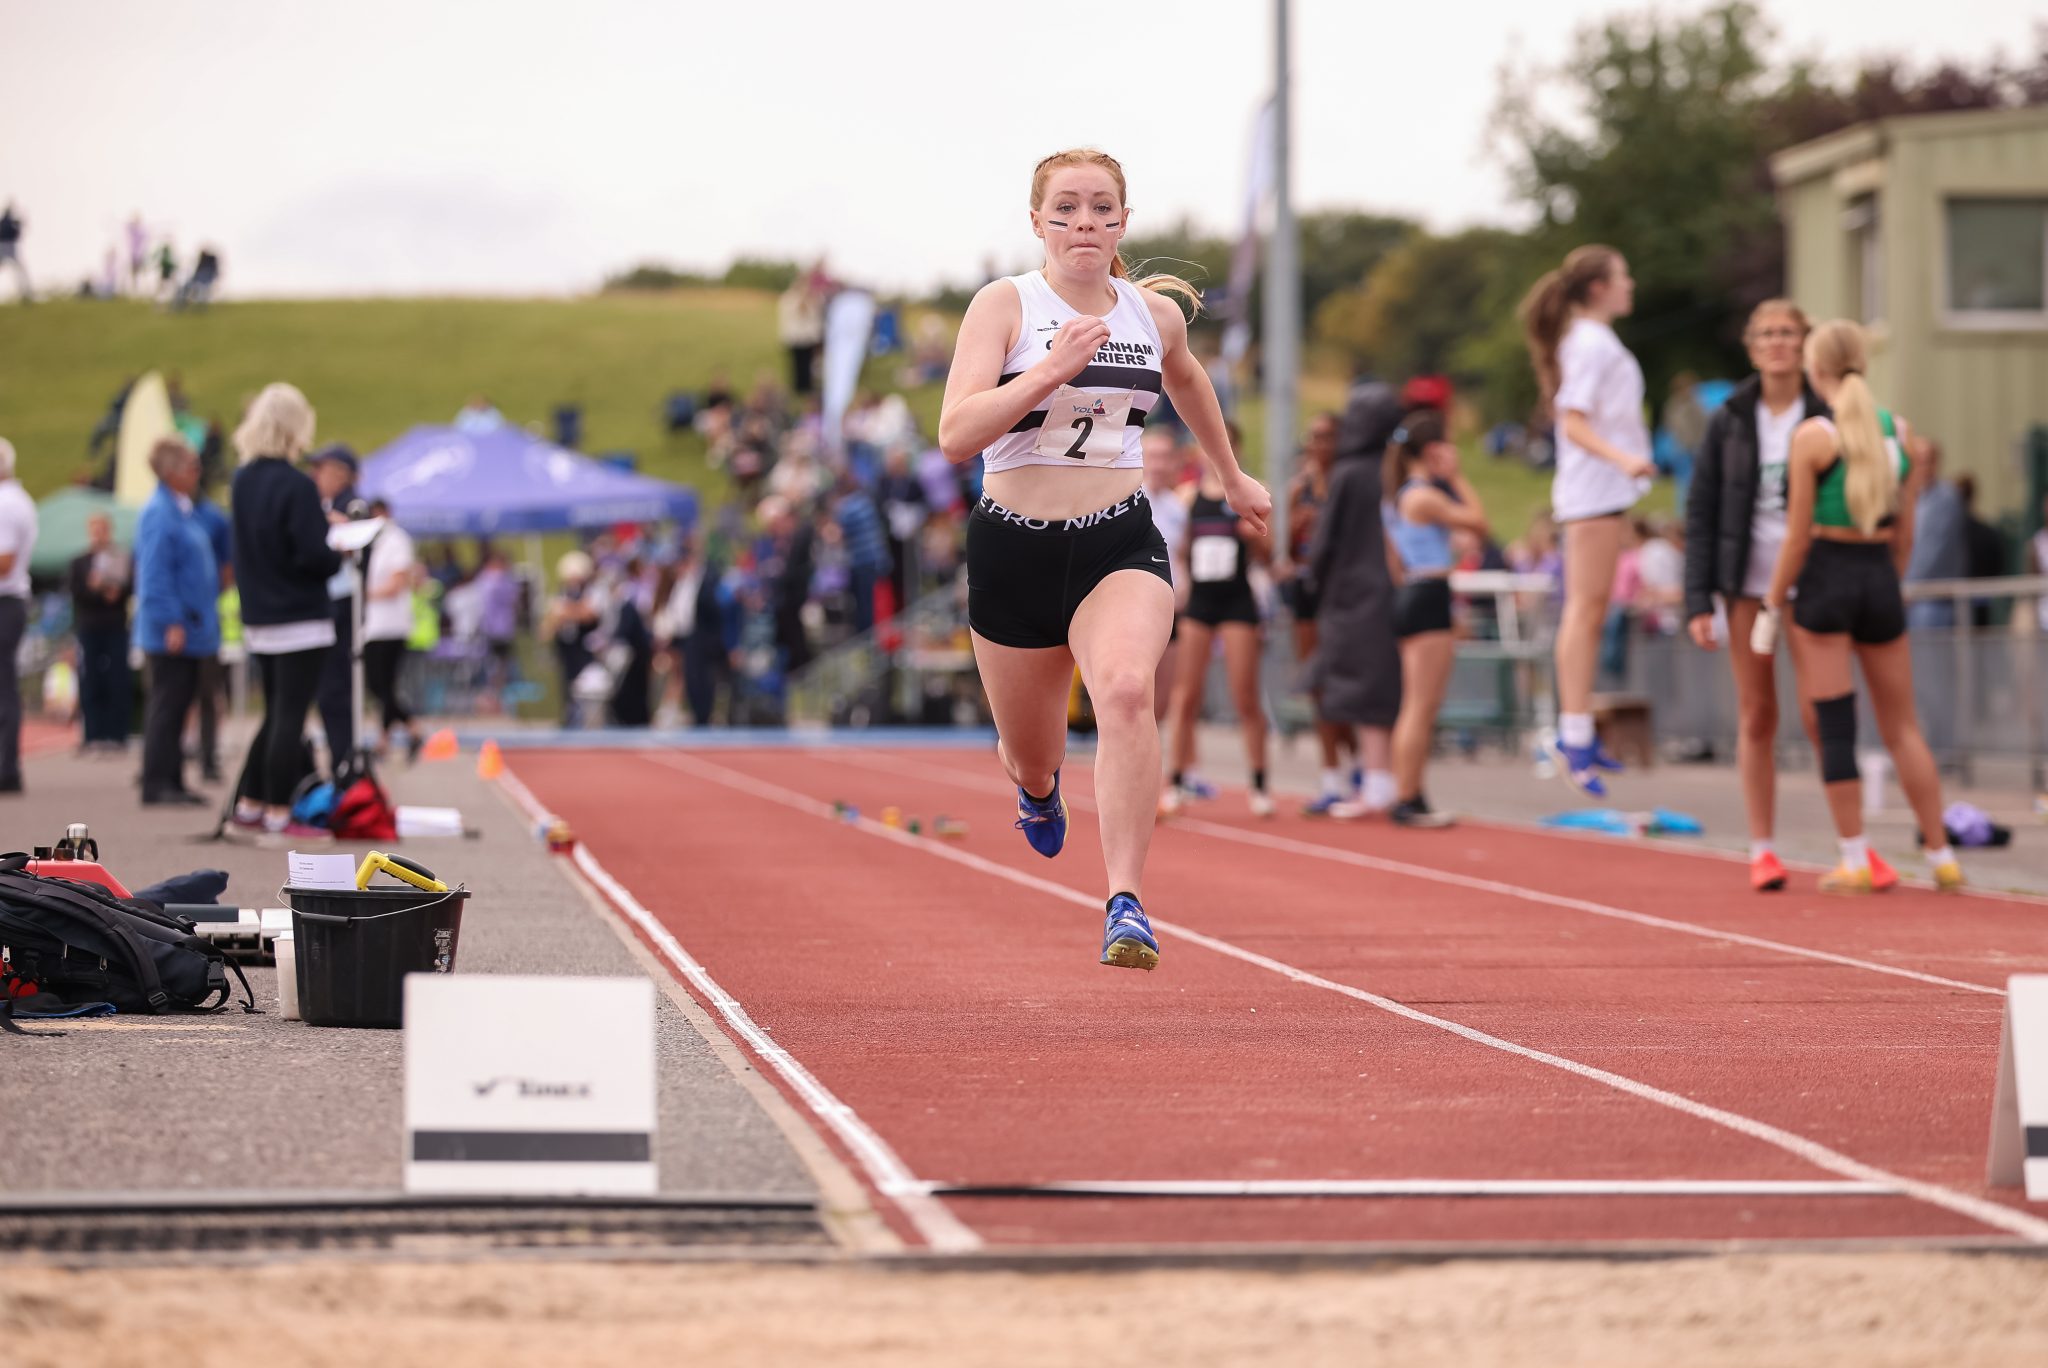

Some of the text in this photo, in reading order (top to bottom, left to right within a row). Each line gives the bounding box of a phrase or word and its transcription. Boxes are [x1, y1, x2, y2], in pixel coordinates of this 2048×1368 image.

[1063, 416, 1094, 460] 2
[988, 498, 1129, 531] PRO NIKE
